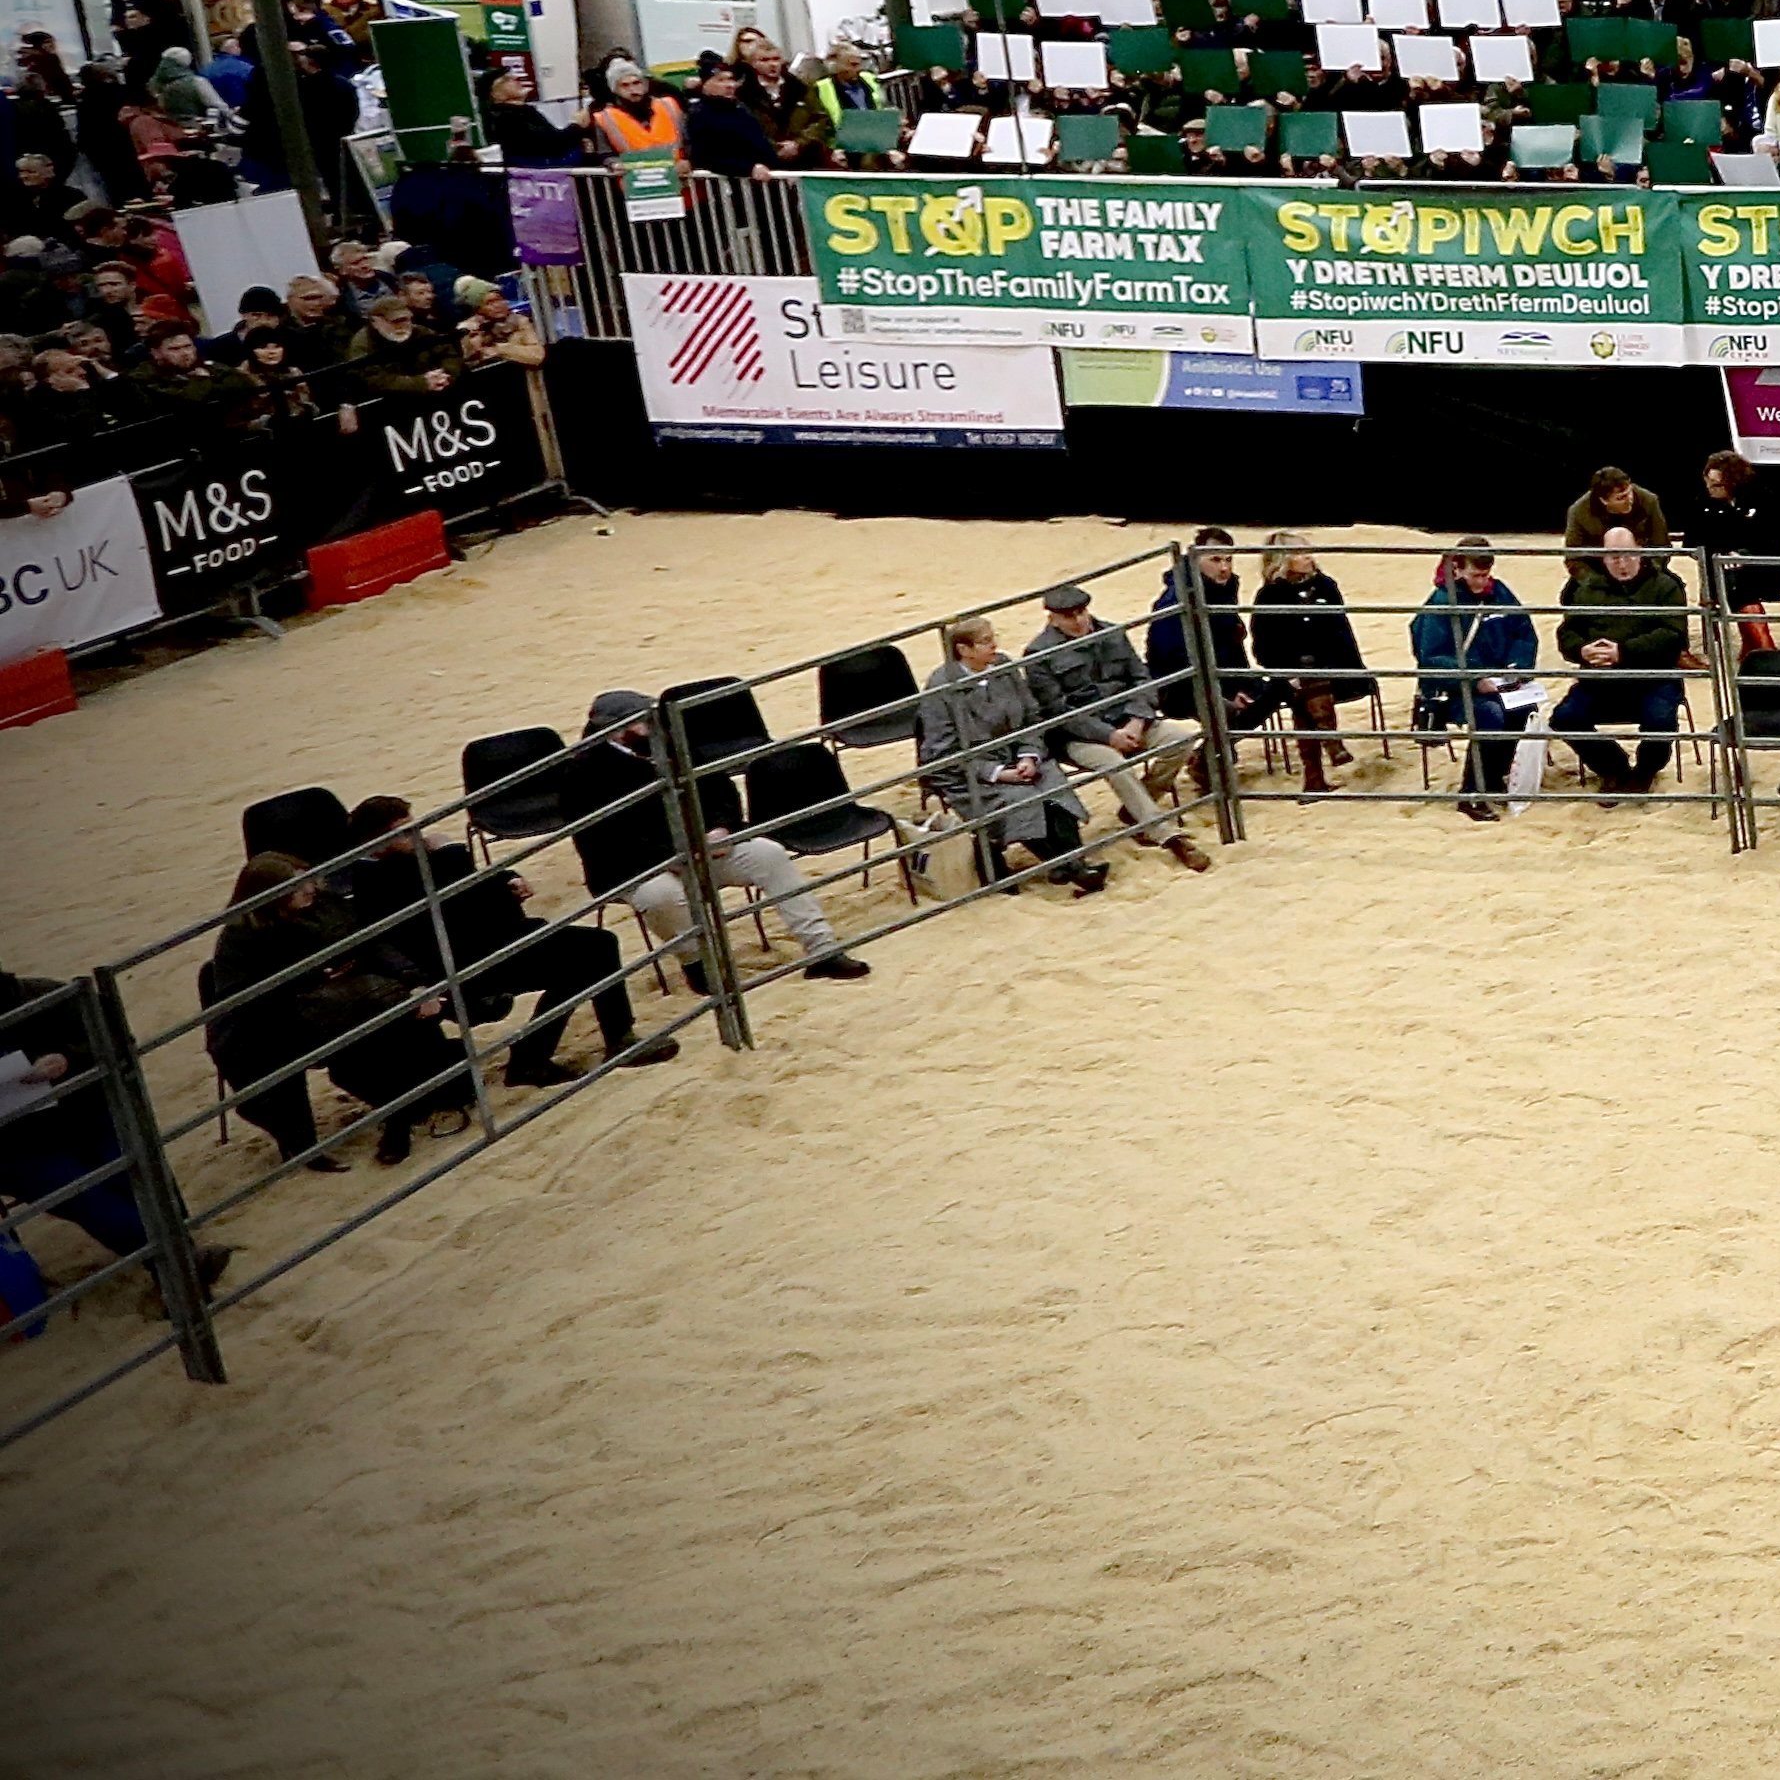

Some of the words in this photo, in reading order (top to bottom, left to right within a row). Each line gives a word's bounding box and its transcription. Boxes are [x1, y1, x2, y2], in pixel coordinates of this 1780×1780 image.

[824, 191, 1035, 258] STOP
[1037, 196, 1103, 227] THE
[1106, 198, 1223, 232] FAMILY
[1277, 201, 1646, 257] STOPIWCH
[1040, 231, 1135, 261] FARM
[1141, 234, 1204, 264] TAX
[836, 267, 1230, 307] #StopTheFamilyFarmTax
[1285, 258, 1307, 285] Y
[1314, 260, 1410, 286] DRETH
[1413, 262, 1508, 288] FFERM
[1512, 263, 1648, 289] DEULUOL
[1700, 264, 1722, 289] Y
[1290, 290, 1650, 317] #StopiwchYDrethFfermDeuluol
[1051, 322, 1085, 339] NFU
[1314, 329, 1353, 345] NFU
[1407, 330, 1464, 355] NFU
[1728, 334, 1767, 351] NFU
[789, 349, 957, 390] Leisure
[702, 405, 785, 420] Memorable
[787, 406, 832, 421] Events
[835, 407, 859, 421] Are
[864, 407, 915, 424] Always
[918, 408, 1004, 423] Streamlined
[384, 399, 497, 473] M&S
[423, 461, 485, 493] FOOD
[154, 468, 273, 552] M&S
[53, 539, 119, 592] UK
[192, 538, 257, 574] FOOD
